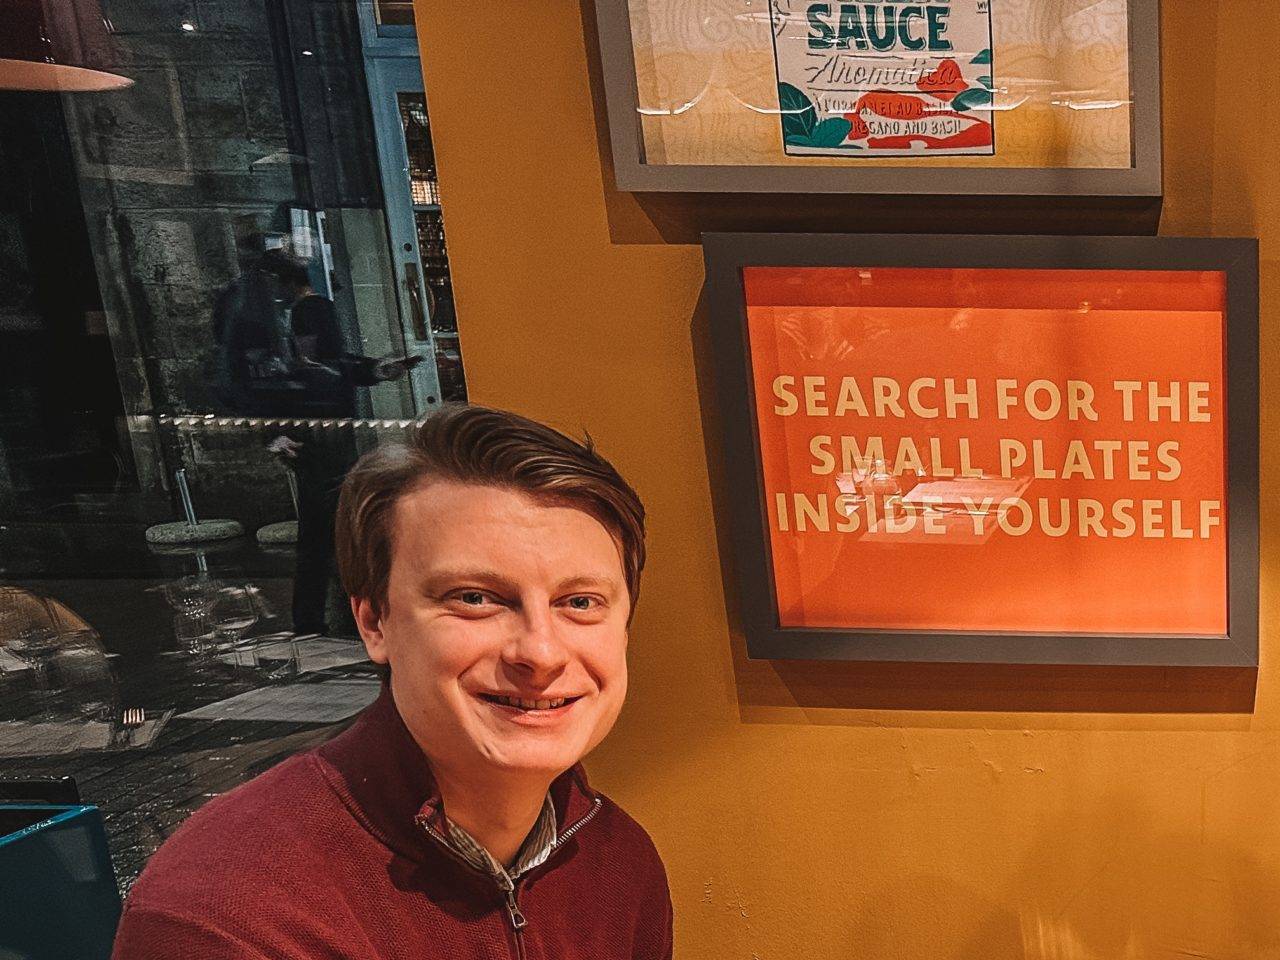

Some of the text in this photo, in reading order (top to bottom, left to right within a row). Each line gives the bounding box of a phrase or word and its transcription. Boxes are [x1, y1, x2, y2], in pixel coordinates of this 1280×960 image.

[806, 4, 953, 51] SAUCE
[771, 375, 1211, 423] SEARCH FOR THE
[808, 435, 1182, 482] SMALL PLATES
[775, 492, 1222, 540] INSIDE YOURSELF
